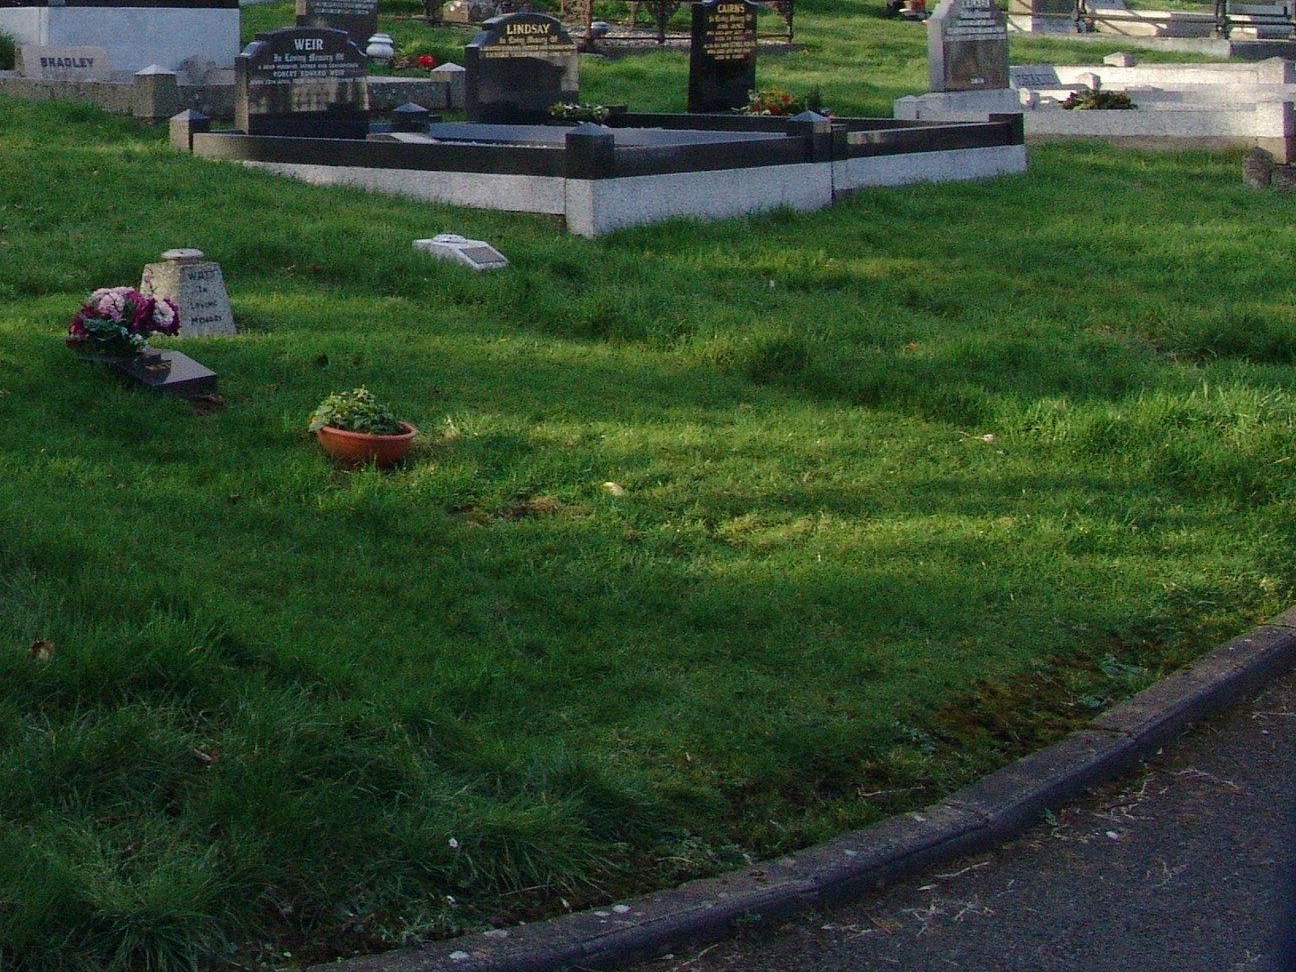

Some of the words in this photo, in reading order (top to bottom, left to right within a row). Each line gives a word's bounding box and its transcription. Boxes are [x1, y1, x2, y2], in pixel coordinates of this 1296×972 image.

[717, 3, 745, 14] CAIRNS
[507, 24, 551, 35] LINDSAY
[294, 38, 324, 50] WEIR
